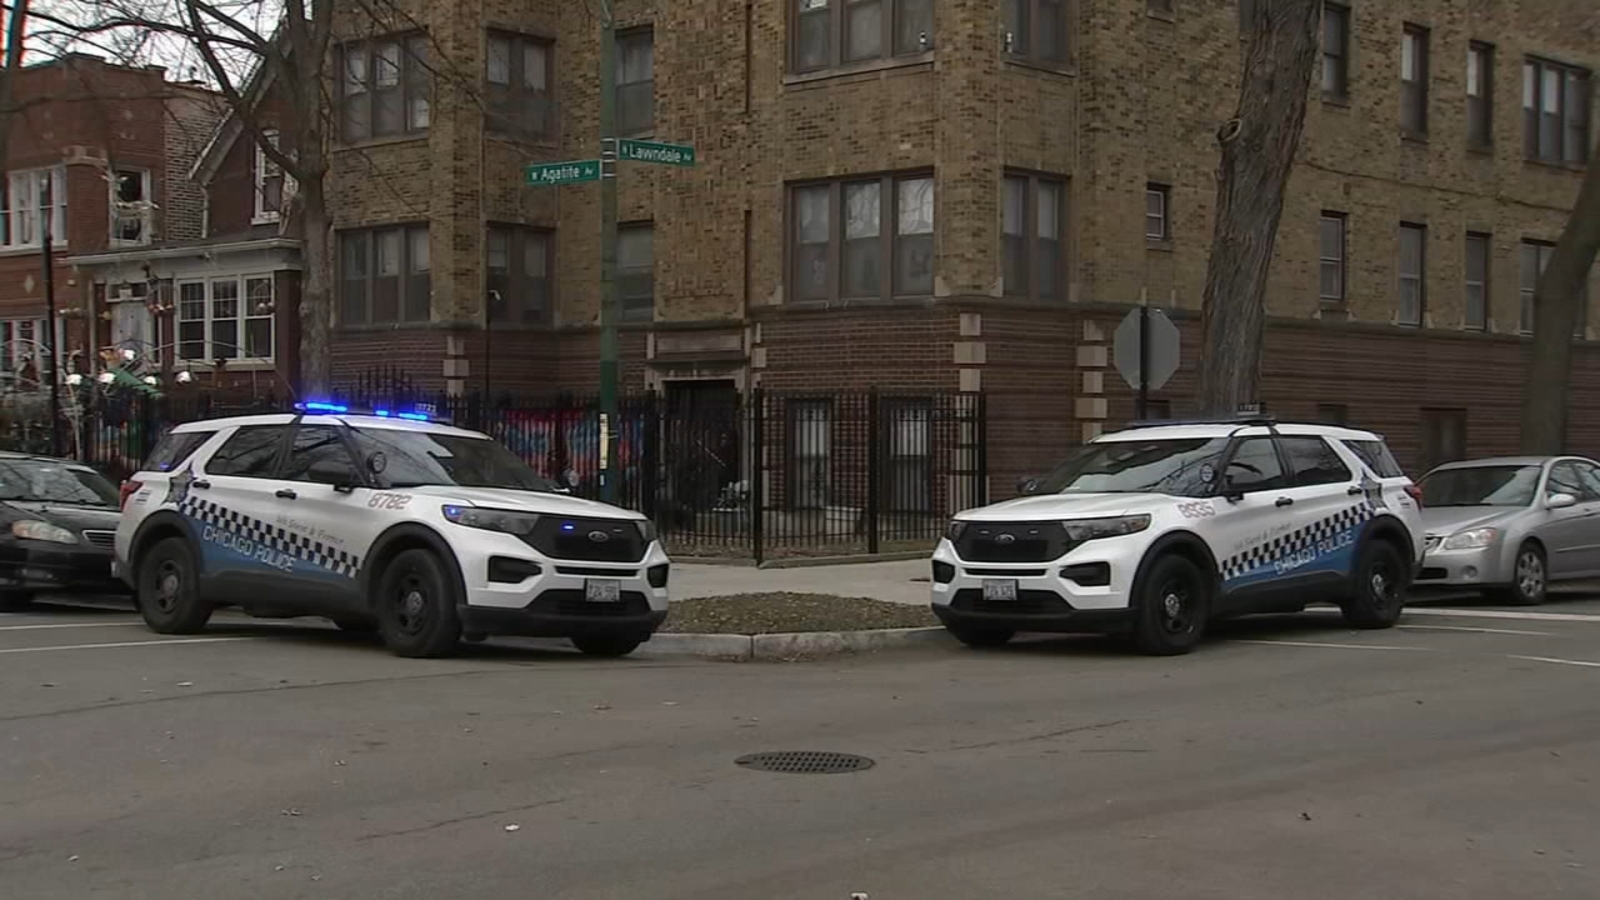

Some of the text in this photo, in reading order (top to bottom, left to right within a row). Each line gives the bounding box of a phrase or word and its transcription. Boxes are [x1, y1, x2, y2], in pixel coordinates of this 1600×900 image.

[629, 144, 681, 163] Lawndale
[540, 166, 580, 183] Agatite
[368, 492, 413, 510] 8782
[202, 525, 253, 556] CHICAGO
[254, 544, 297, 572] POLICE
